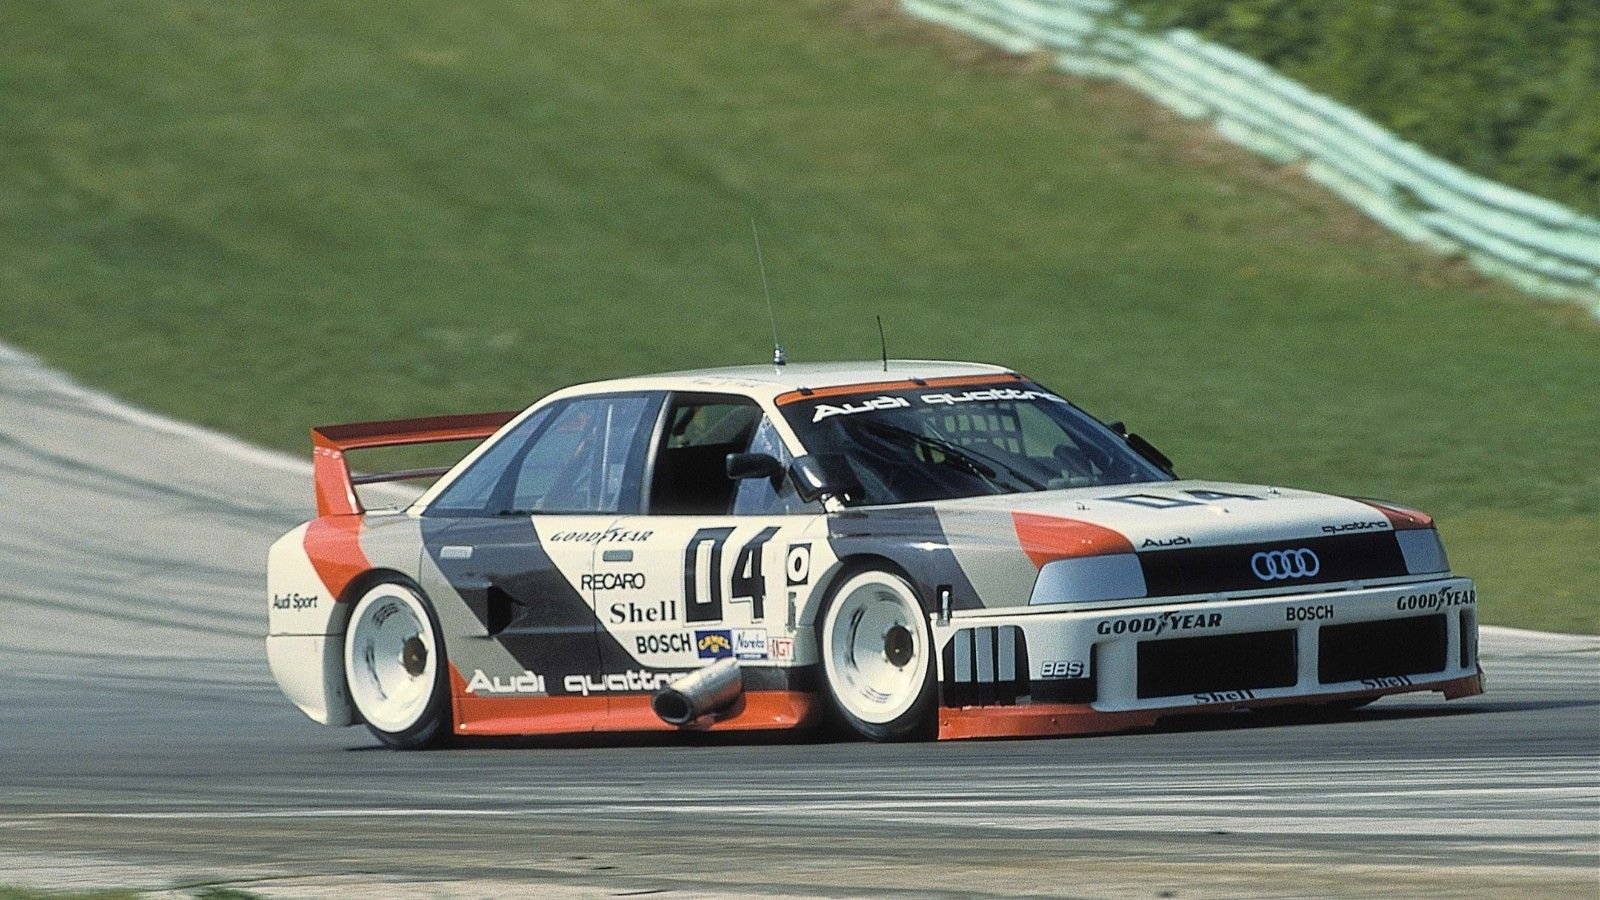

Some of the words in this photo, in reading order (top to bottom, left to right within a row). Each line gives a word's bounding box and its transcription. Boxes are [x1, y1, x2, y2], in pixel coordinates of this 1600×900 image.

[812, 396, 910, 423] Audi
[920, 388, 1068, 405] quattro
[1322, 521, 1388, 534] quattro
[1141, 536, 1192, 548] Audi
[581, 573, 646, 590] RECARO
[684, 526, 782, 622] 04
[273, 594, 290, 609] Audi
[293, 593, 318, 612] Sport
[610, 600, 677, 624] Shell
[1286, 605, 1334, 622] BOSCH
[636, 633, 692, 654] BOSCH
[1041, 660, 1083, 677] BBS
[465, 669, 546, 693] Audi
[1360, 675, 1412, 689] Shell
[1193, 690, 1254, 704] Shell
